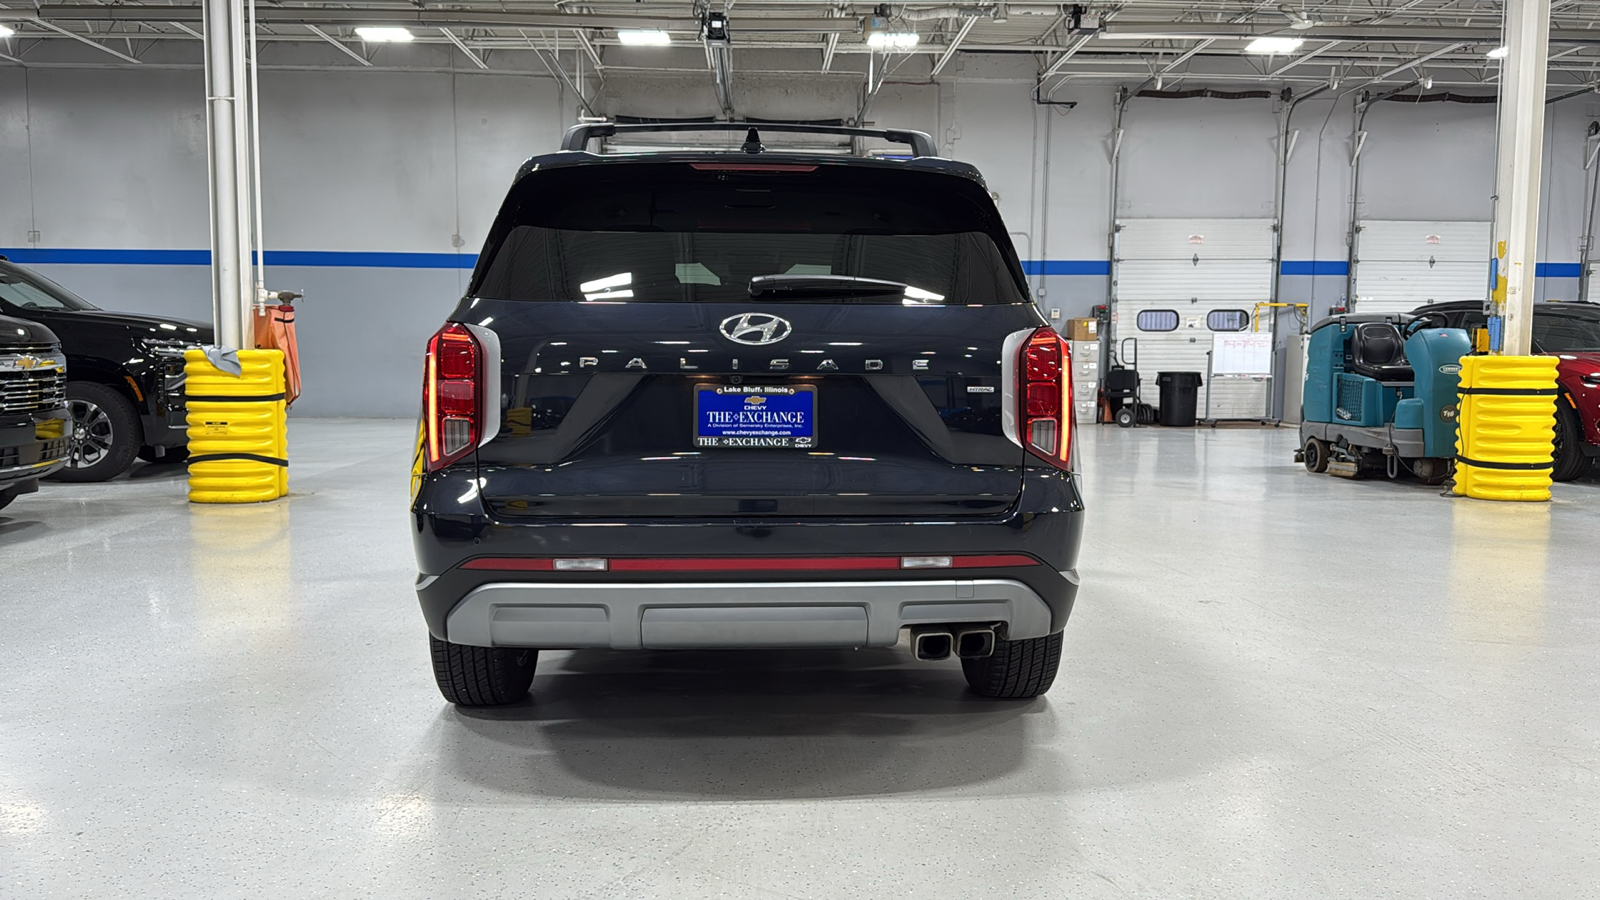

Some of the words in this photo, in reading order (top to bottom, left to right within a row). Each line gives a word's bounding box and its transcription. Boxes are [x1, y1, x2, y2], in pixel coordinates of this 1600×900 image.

[579, 357, 930, 370] PALISADE
[706, 412, 733, 422] THE
[740, 412, 804, 423] EXCHANGE
[698, 438, 718, 446] THE
[729, 438, 789, 446] EXCHANGE
